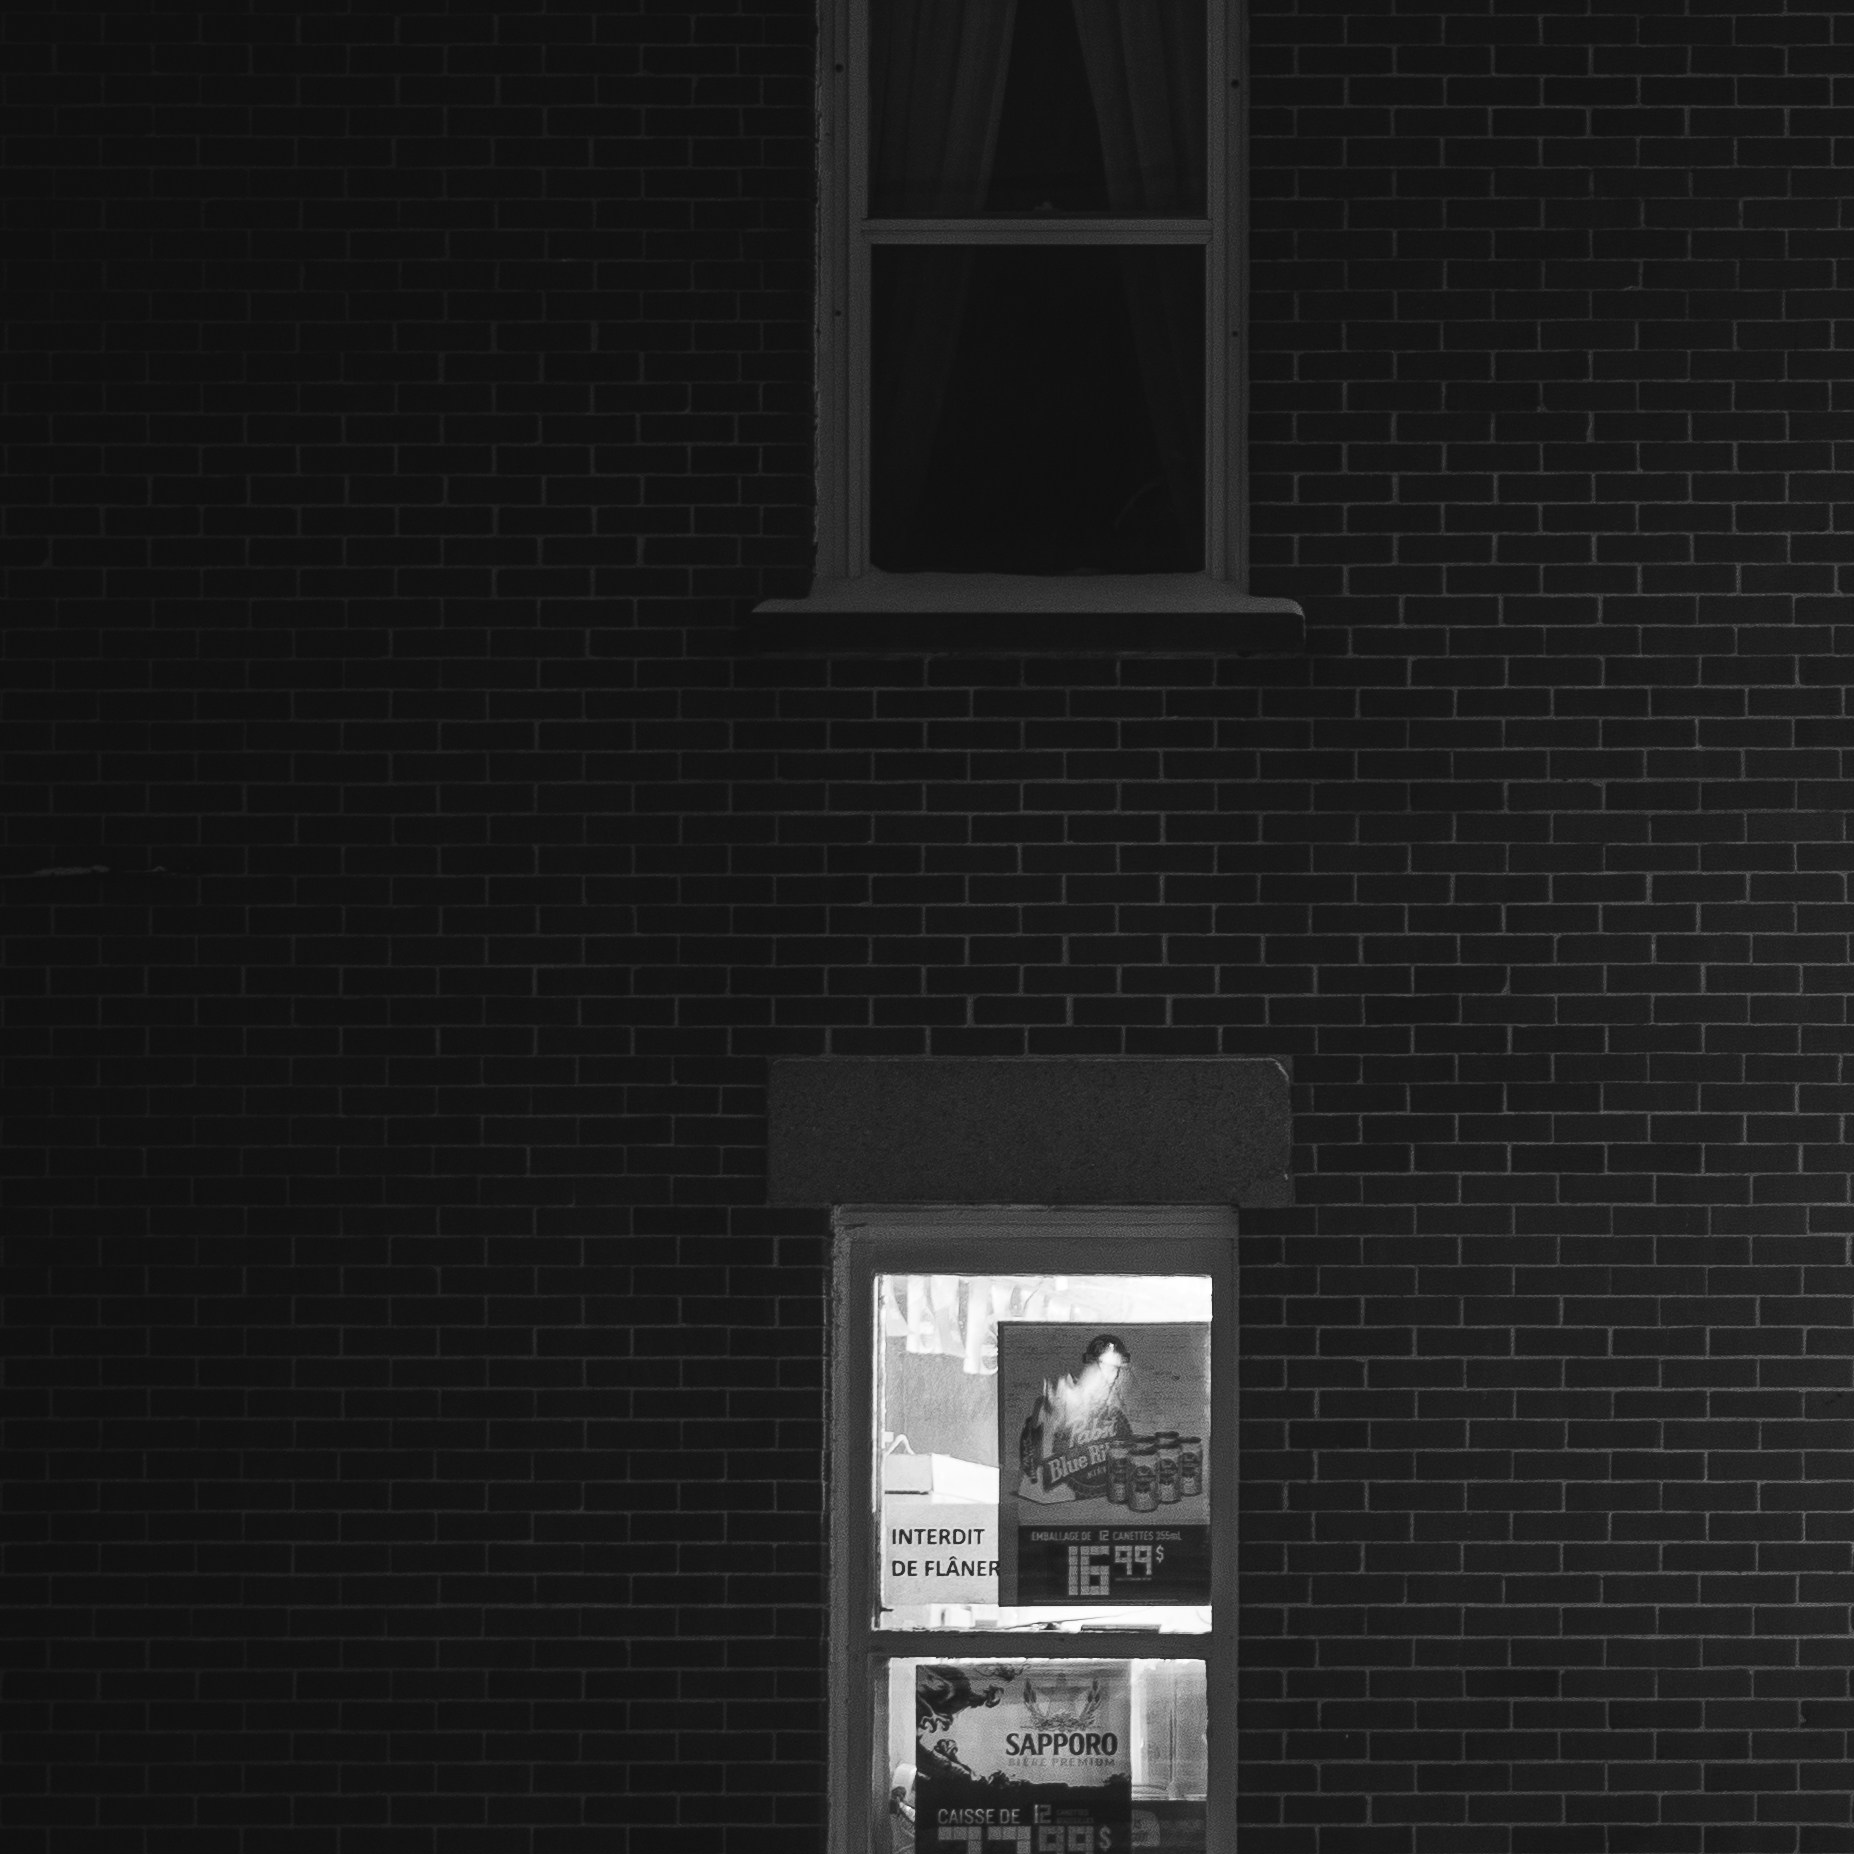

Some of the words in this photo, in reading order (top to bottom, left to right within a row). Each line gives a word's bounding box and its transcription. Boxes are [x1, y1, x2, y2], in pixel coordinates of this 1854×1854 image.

[892, 1528, 986, 1545] INTERDIT
[1031, 1531, 1080, 1541] EMBALLAGE
[1081, 1531, 1091, 1541] DE
[1100, 1530, 1109, 1541] 12
[1112, 1531, 1154, 1542] CANETTES
[892, 1560, 918, 1577] DE
[925, 1555, 1000, 1577] FLÂNER
[1005, 1732, 1119, 1756] SAPPORO
[937, 1807, 995, 1825] CAISSE
[1000, 1807, 1021, 1824] DE
[1033, 1803, 1052, 1825] 12
